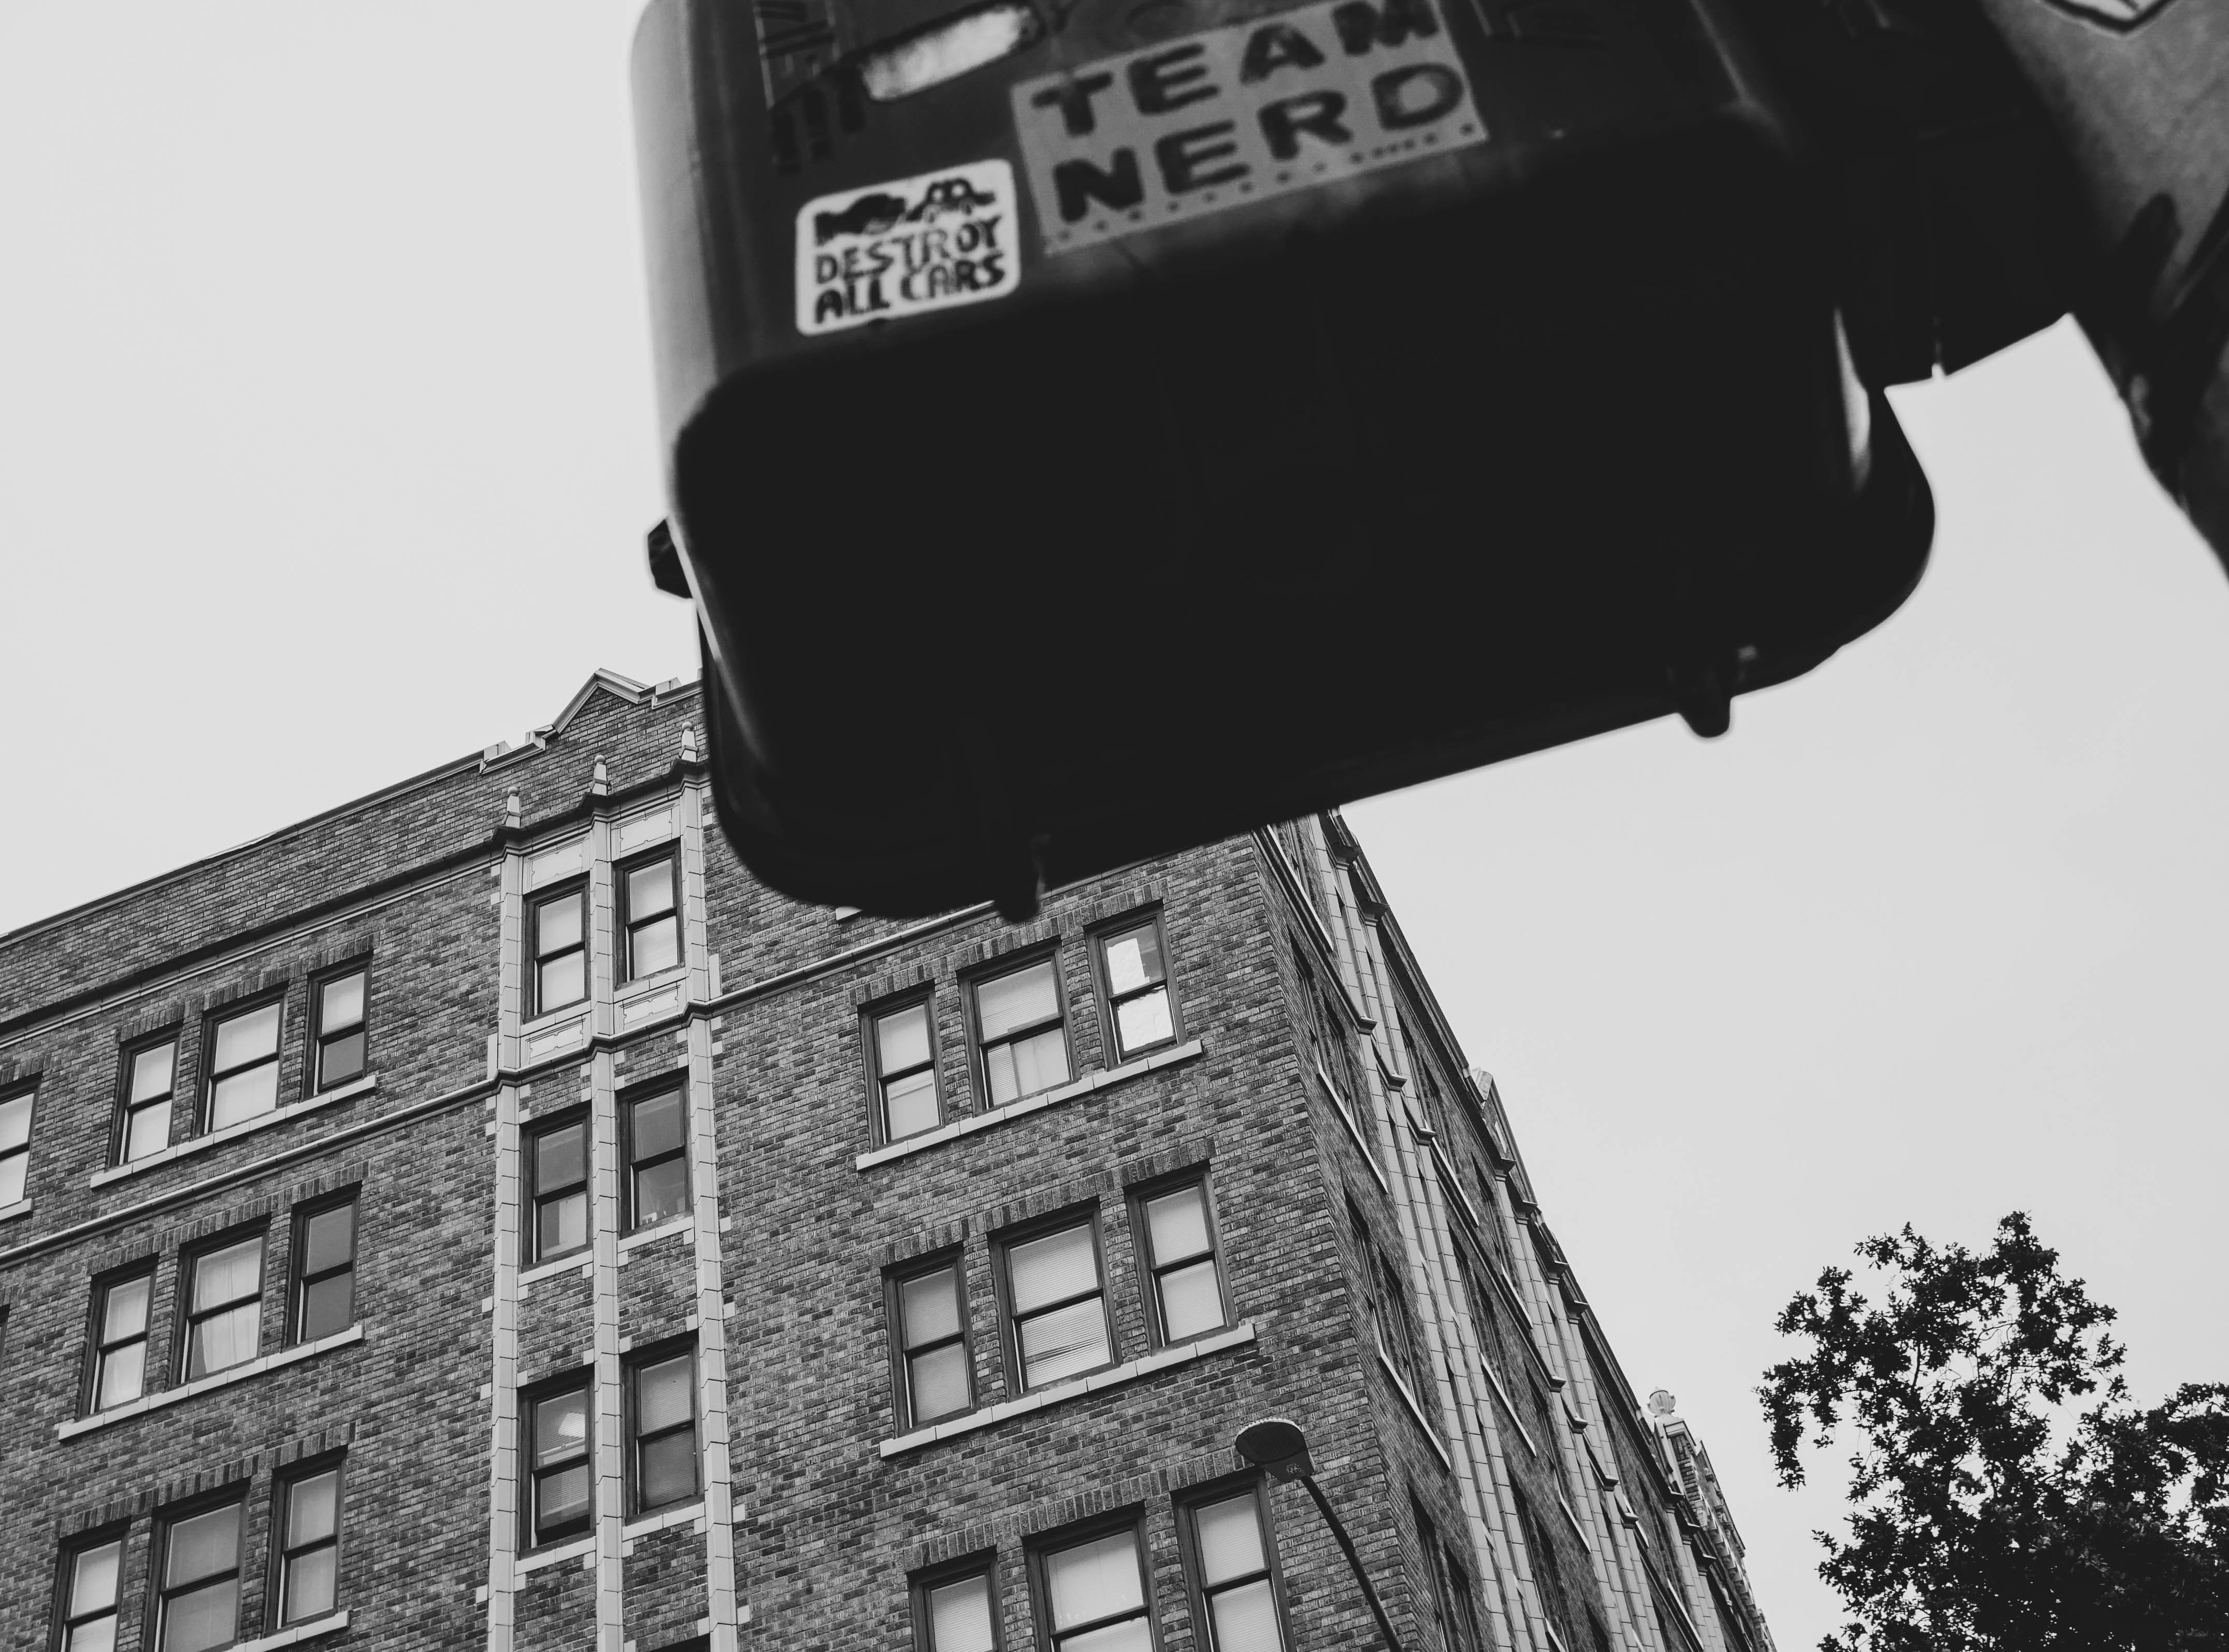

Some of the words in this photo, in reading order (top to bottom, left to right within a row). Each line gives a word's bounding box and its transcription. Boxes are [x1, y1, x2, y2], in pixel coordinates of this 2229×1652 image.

[1031, 0, 1439, 137] TEAM
[1054, 63, 1463, 222] NERD
[814, 278, 891, 324] ALL
[900, 251, 1005, 300] CARS
[816, 216, 1001, 284] DESTROY
